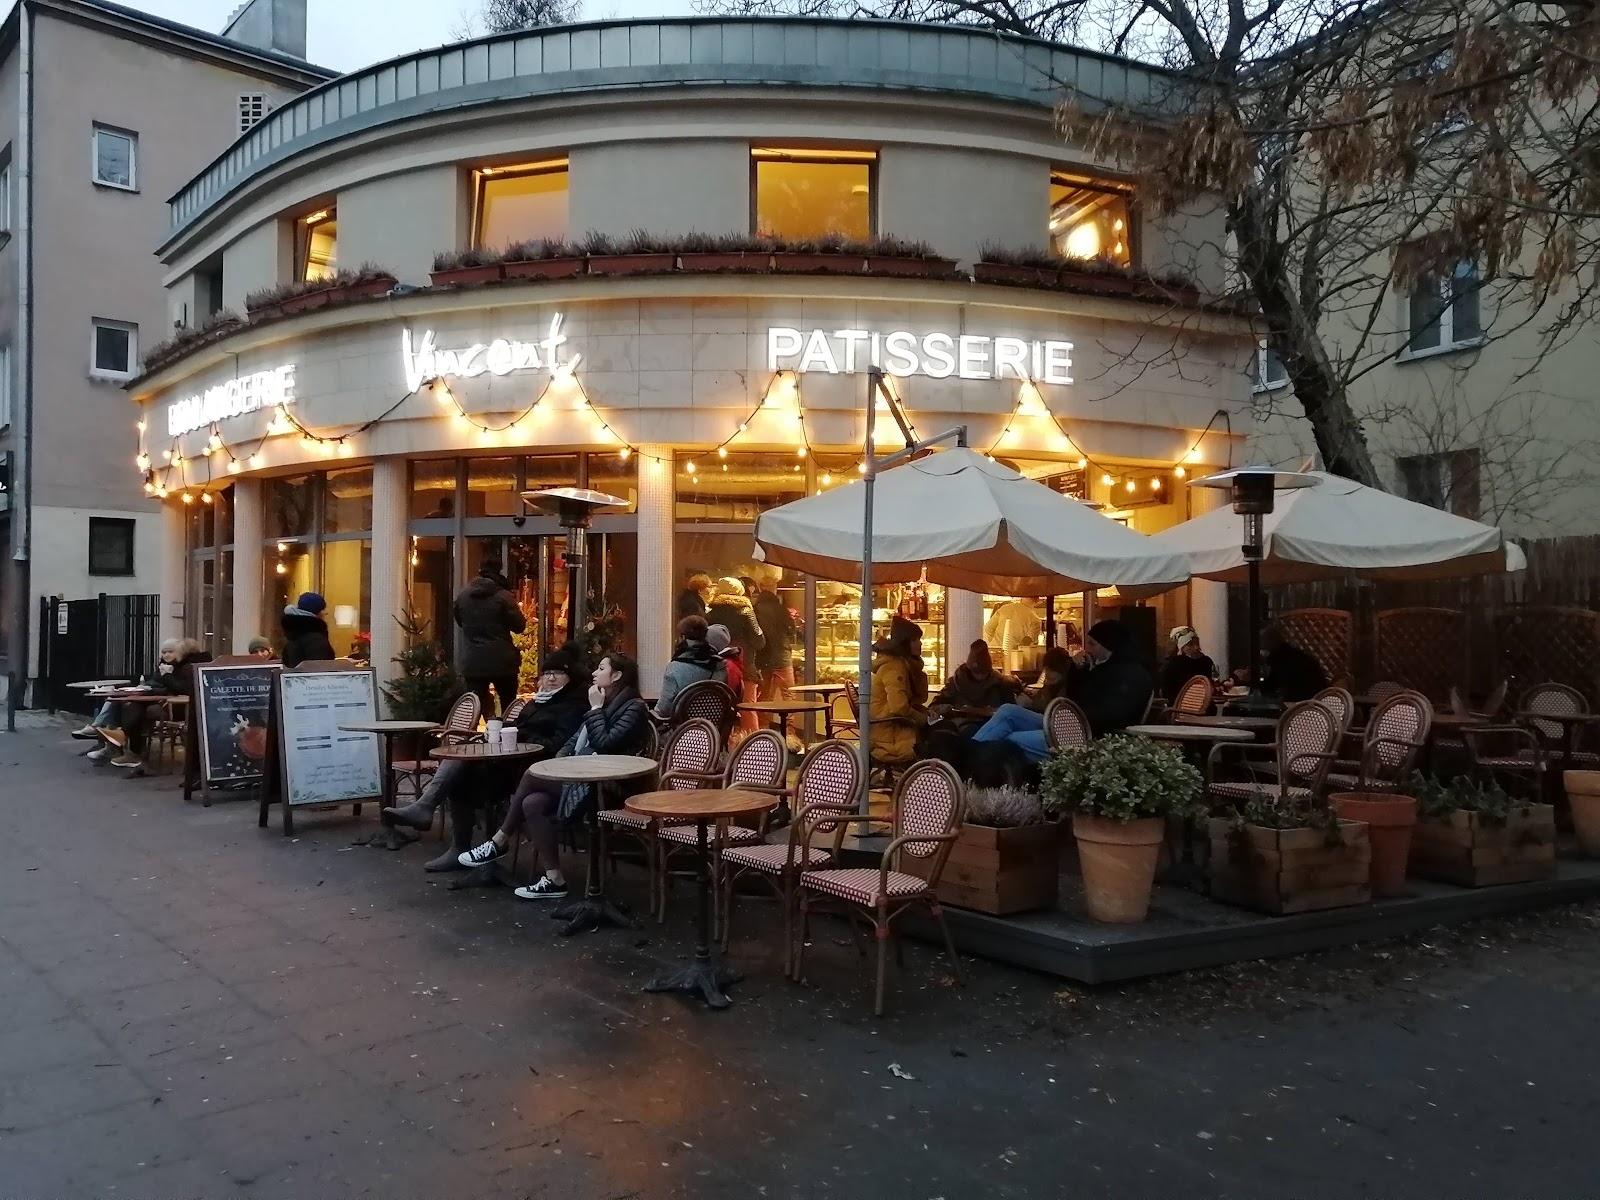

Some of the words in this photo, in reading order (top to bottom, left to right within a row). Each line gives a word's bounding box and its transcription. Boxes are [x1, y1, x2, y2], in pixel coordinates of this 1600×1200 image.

[402, 312, 582, 393] Vincent
[767, 327, 1075, 385] PATISSERIE
[210, 685, 245, 694] GALETTE
